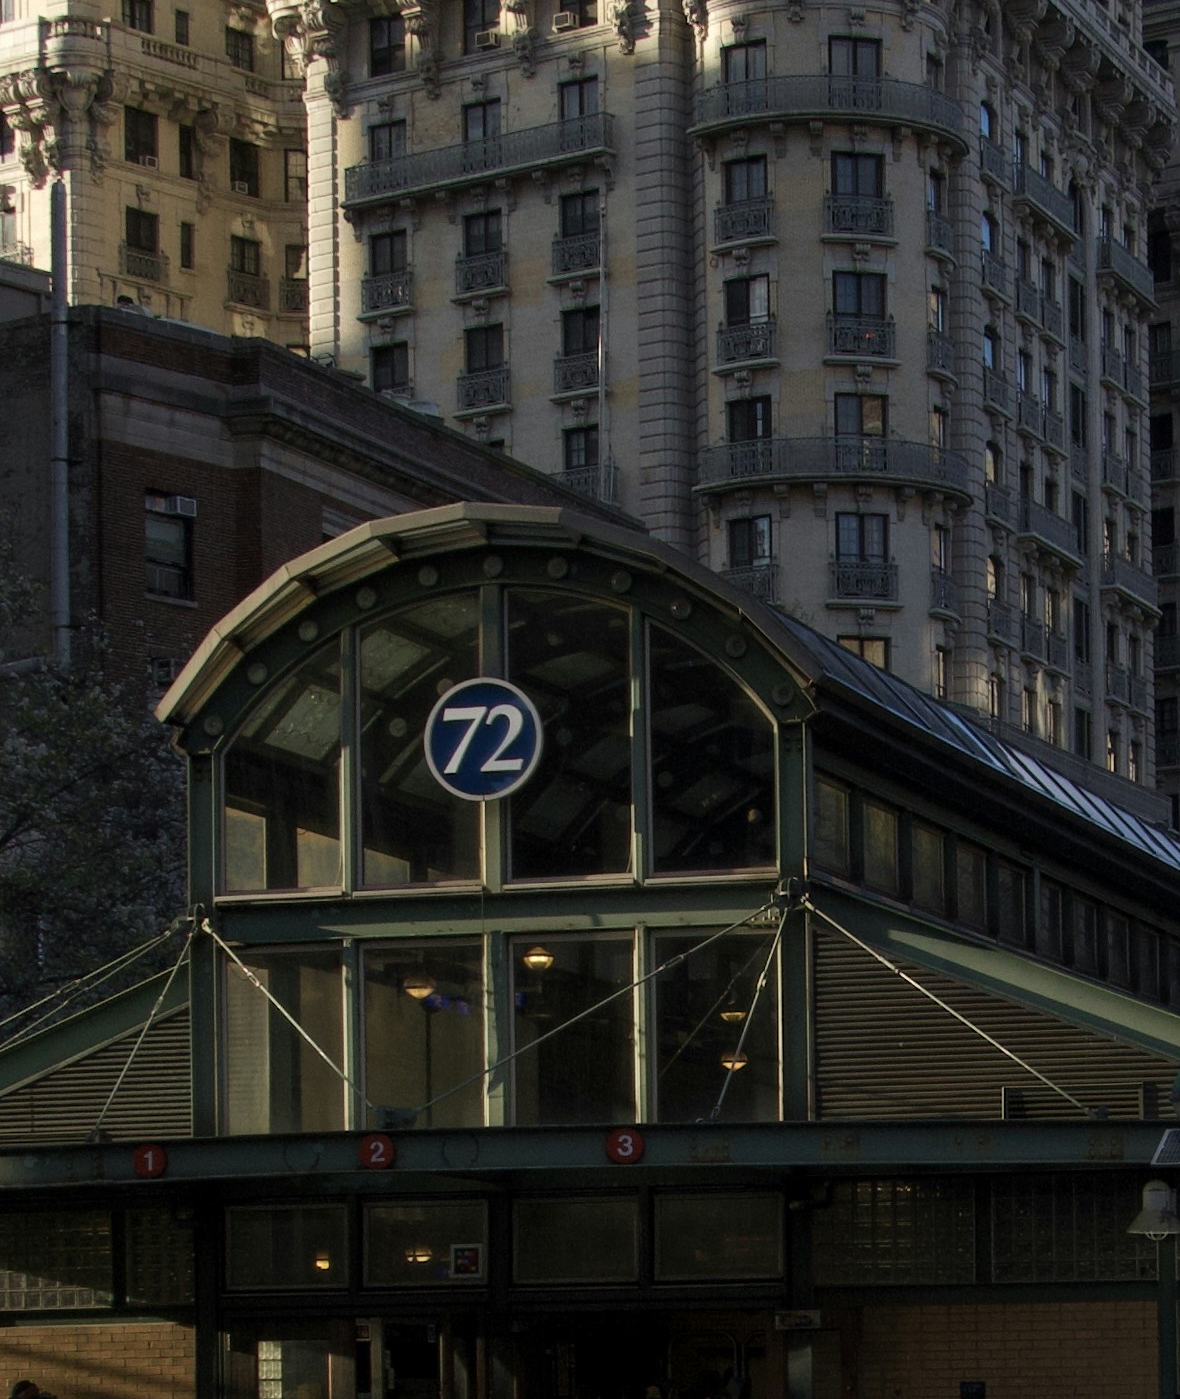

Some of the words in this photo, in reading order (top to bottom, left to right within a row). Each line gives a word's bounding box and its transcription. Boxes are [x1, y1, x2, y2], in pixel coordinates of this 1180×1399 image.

[443, 704, 524, 775] 72
[369, 1141, 385, 1163] 2
[616, 1134, 634, 1157] 3
[143, 1150, 154, 1172] 1
